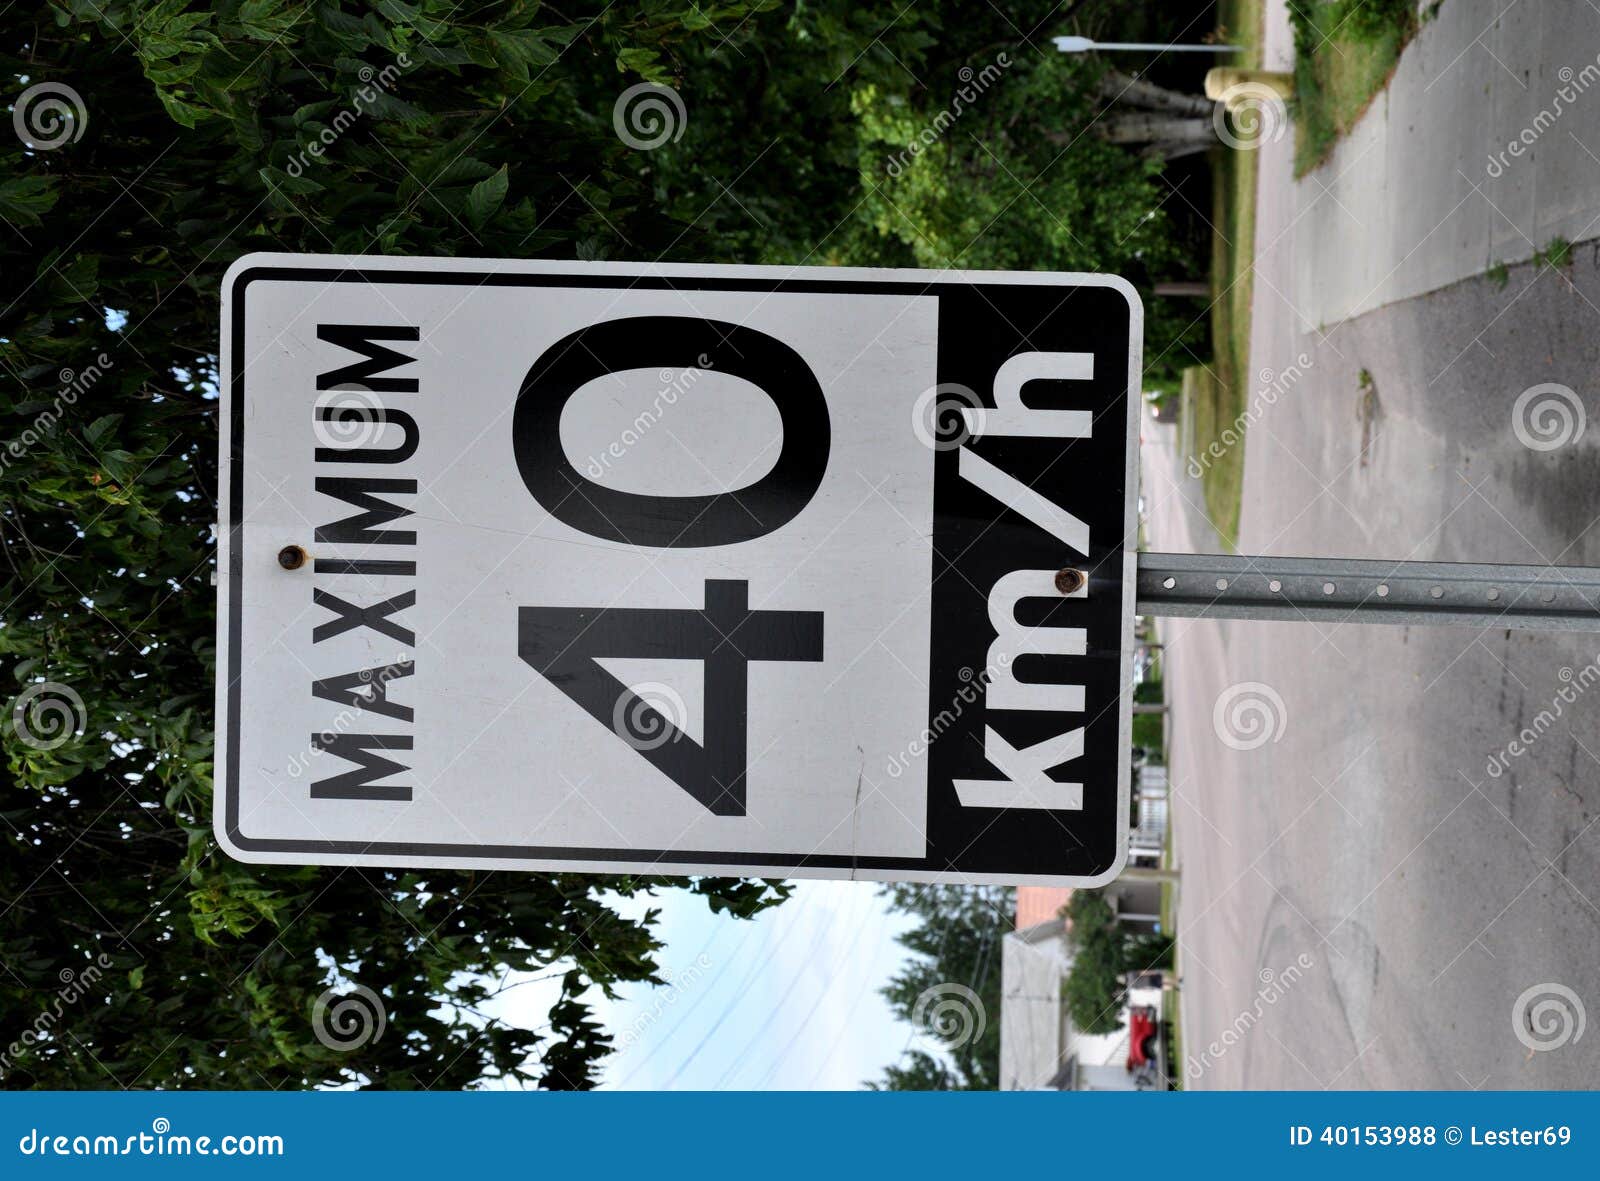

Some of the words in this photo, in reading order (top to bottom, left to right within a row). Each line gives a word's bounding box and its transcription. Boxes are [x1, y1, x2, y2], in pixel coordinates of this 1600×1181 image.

[310, 324, 420, 801] MAXIMUM
[513, 316, 831, 816] 40
[952, 351, 1094, 810] km/h
